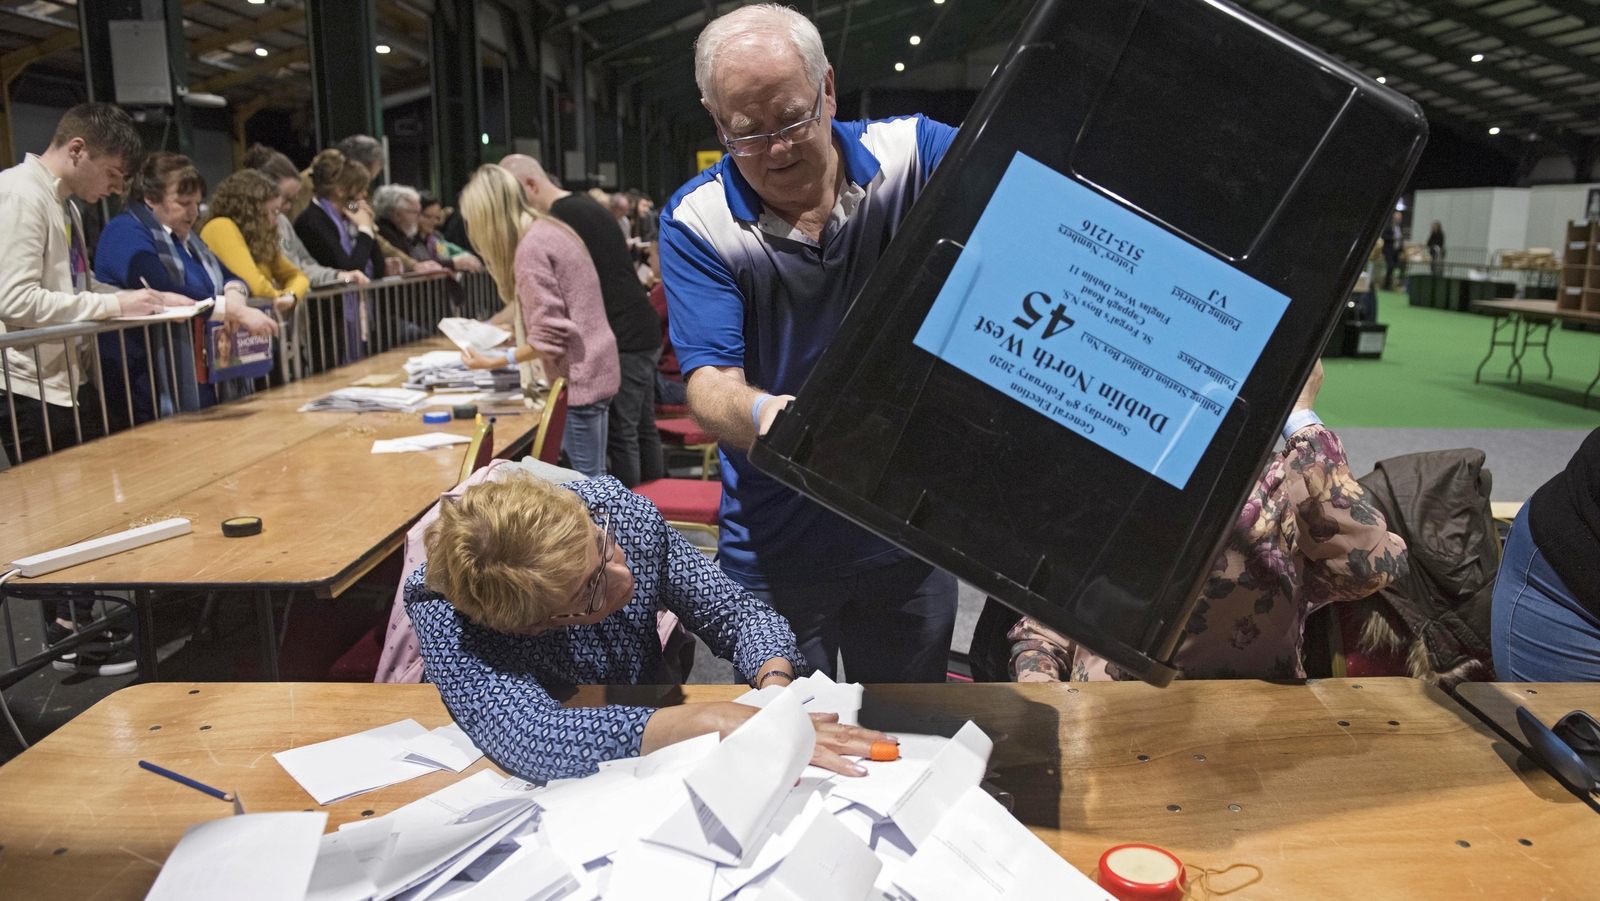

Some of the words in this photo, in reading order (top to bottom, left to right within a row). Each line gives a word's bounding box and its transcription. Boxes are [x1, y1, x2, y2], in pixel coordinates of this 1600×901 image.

[1058, 224, 1103, 255] Numbers
[1081, 219, 1144, 261] 513-1216
[1069, 264, 1079, 275] 11
[1100, 247, 1138, 274] Voters'
[1080, 285, 1105, 304] Road
[1081, 271, 1111, 292] Dublin
[1062, 288, 1081, 306] N.S.
[1081, 299, 1104, 318] Boys
[1113, 286, 1137, 308] West,
[1171, 285, 1209, 312] District
[1207, 289, 1226, 308] VJ
[1012, 291, 1075, 340] 45
[1104, 313, 1139, 337] Fergal's
[1106, 299, 1145, 325] Cappagh
[1140, 302, 1170, 325] Finglas
[1208, 304, 1242, 331] Polling
[974, 316, 1023, 357] West
[1080, 331, 1104, 350] No.)
[1141, 331, 1154, 345] St.
[989, 354, 1015, 373] 2020
[1103, 342, 1123, 361] Box
[1177, 350, 1205, 372] Place
[1033, 346, 1094, 393] North
[1122, 353, 1156, 377] (Ballot
[1203, 364, 1238, 390] Polling
[1010, 382, 1052, 411] Election
[1018, 367, 1065, 401] February
[1155, 370, 1191, 397] Station
[1065, 399, 1082, 410] 8th
[1098, 382, 1169, 434] Dublin
[1189, 389, 1224, 416] Polling
[1052, 406, 1095, 434] General
[1084, 403, 1130, 436] Saturday
